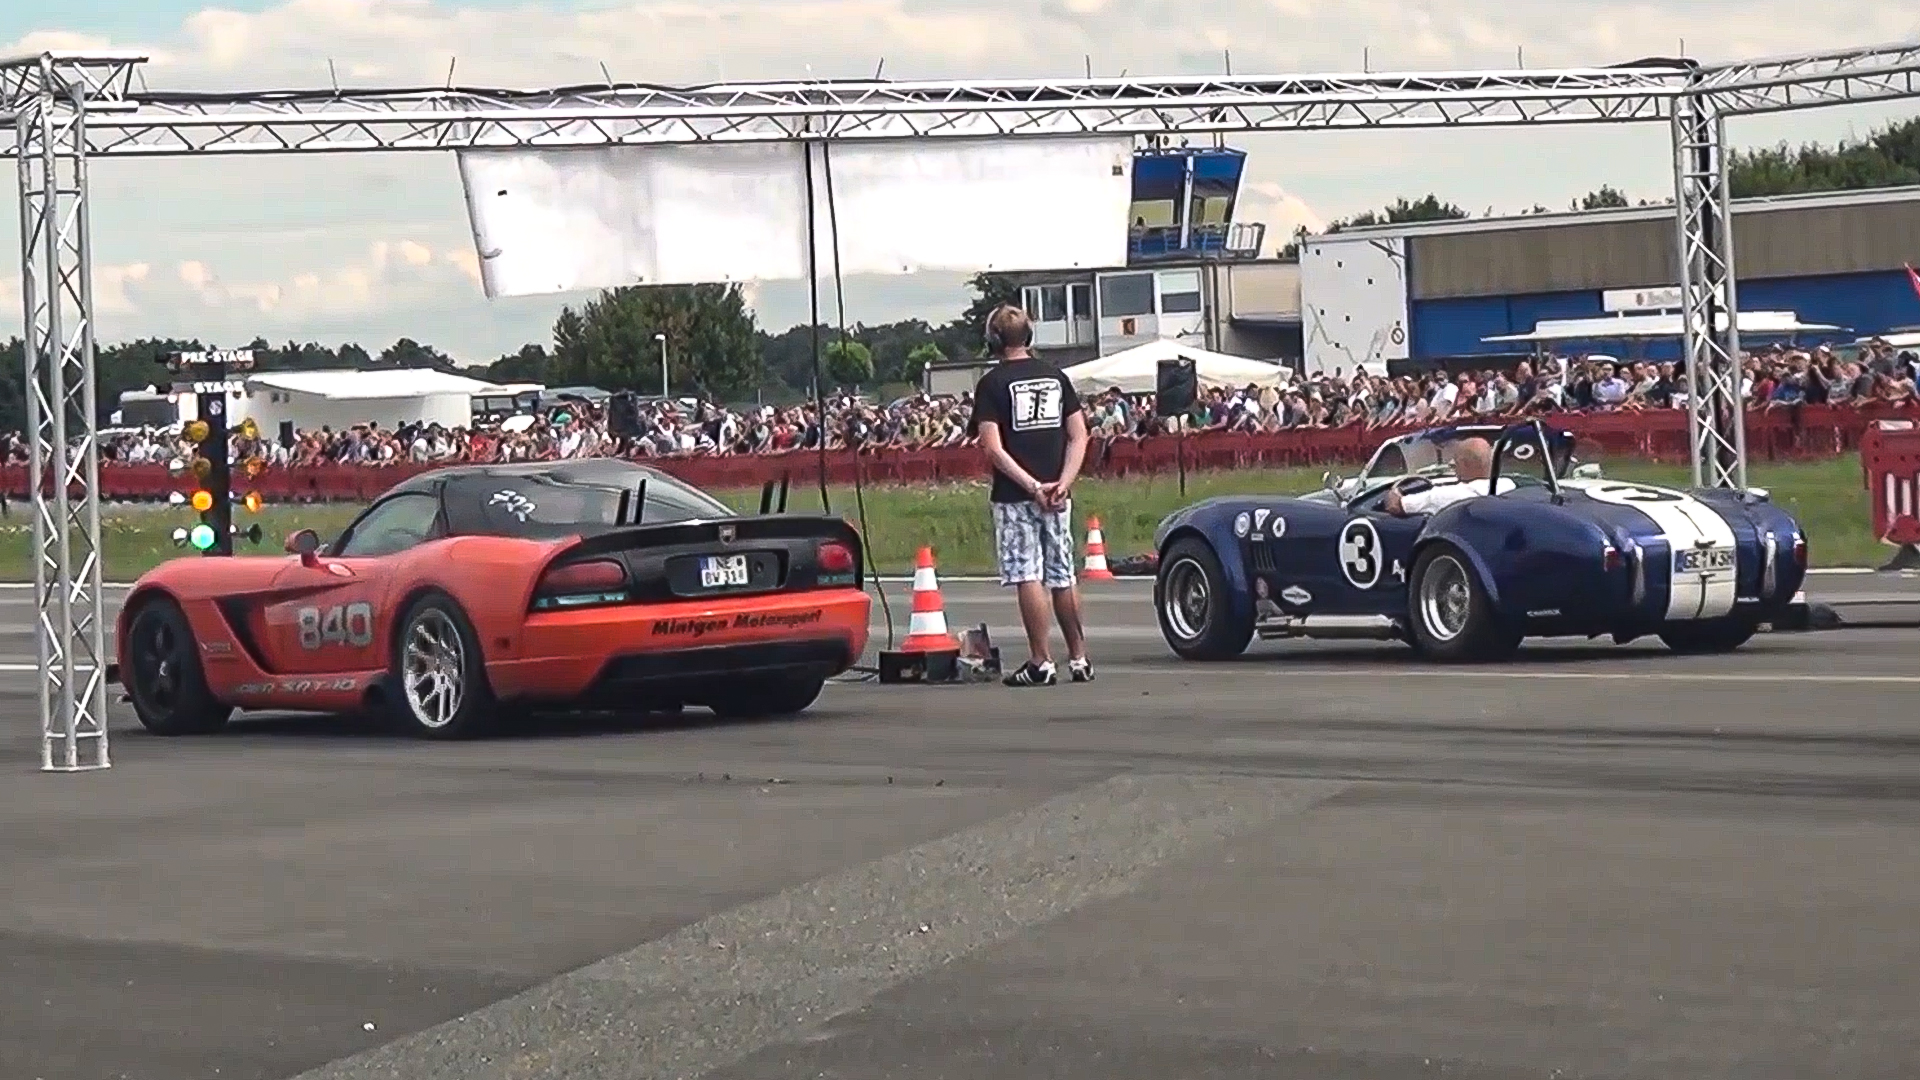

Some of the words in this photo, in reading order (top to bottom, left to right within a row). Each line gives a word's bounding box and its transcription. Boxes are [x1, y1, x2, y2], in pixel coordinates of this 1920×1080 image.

[181, 351, 254, 363] PRE-STAGE
[193, 381, 245, 394] STAGE
[1345, 523, 1377, 584] 3
[299, 602, 373, 650] 840
[652, 618, 728, 638] Mintgen
